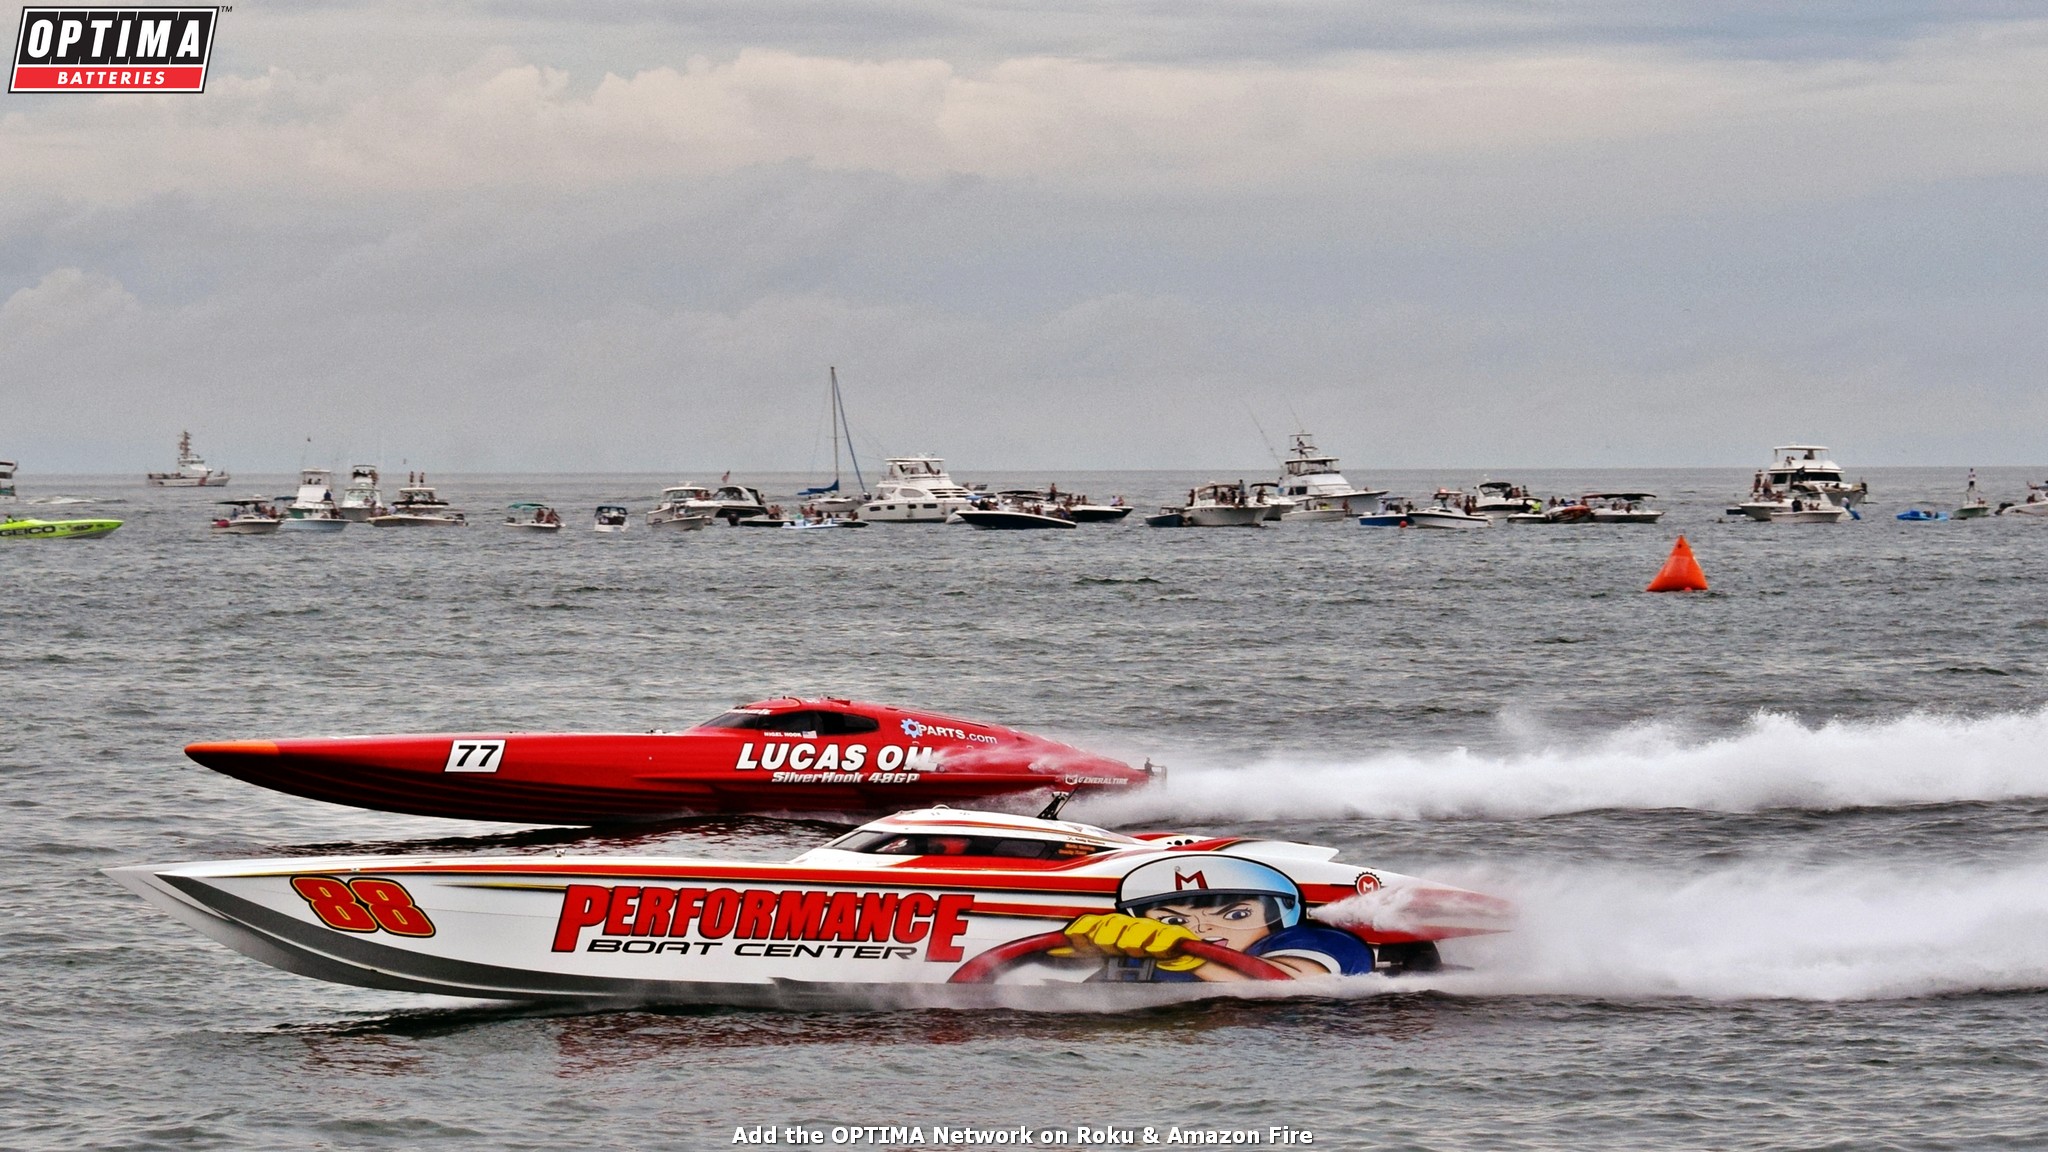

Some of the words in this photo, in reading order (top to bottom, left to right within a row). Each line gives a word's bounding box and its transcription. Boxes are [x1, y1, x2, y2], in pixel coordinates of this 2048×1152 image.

[0, 525, 56, 537] GEICO
[456, 745, 499, 767] 77
[736, 743, 868, 771] LUCAS
[877, 745, 939, 771] OIL
[771, 772, 866, 783] SilverHook
[868, 773, 920, 784] 48GP
[1175, 870, 1208, 890] M
[1362, 880, 1374, 892] M
[290, 875, 436, 938] 88
[551, 884, 974, 963] PERFORMANCE
[586, 939, 723, 955] BOAT
[733, 942, 917, 961] CENTER
